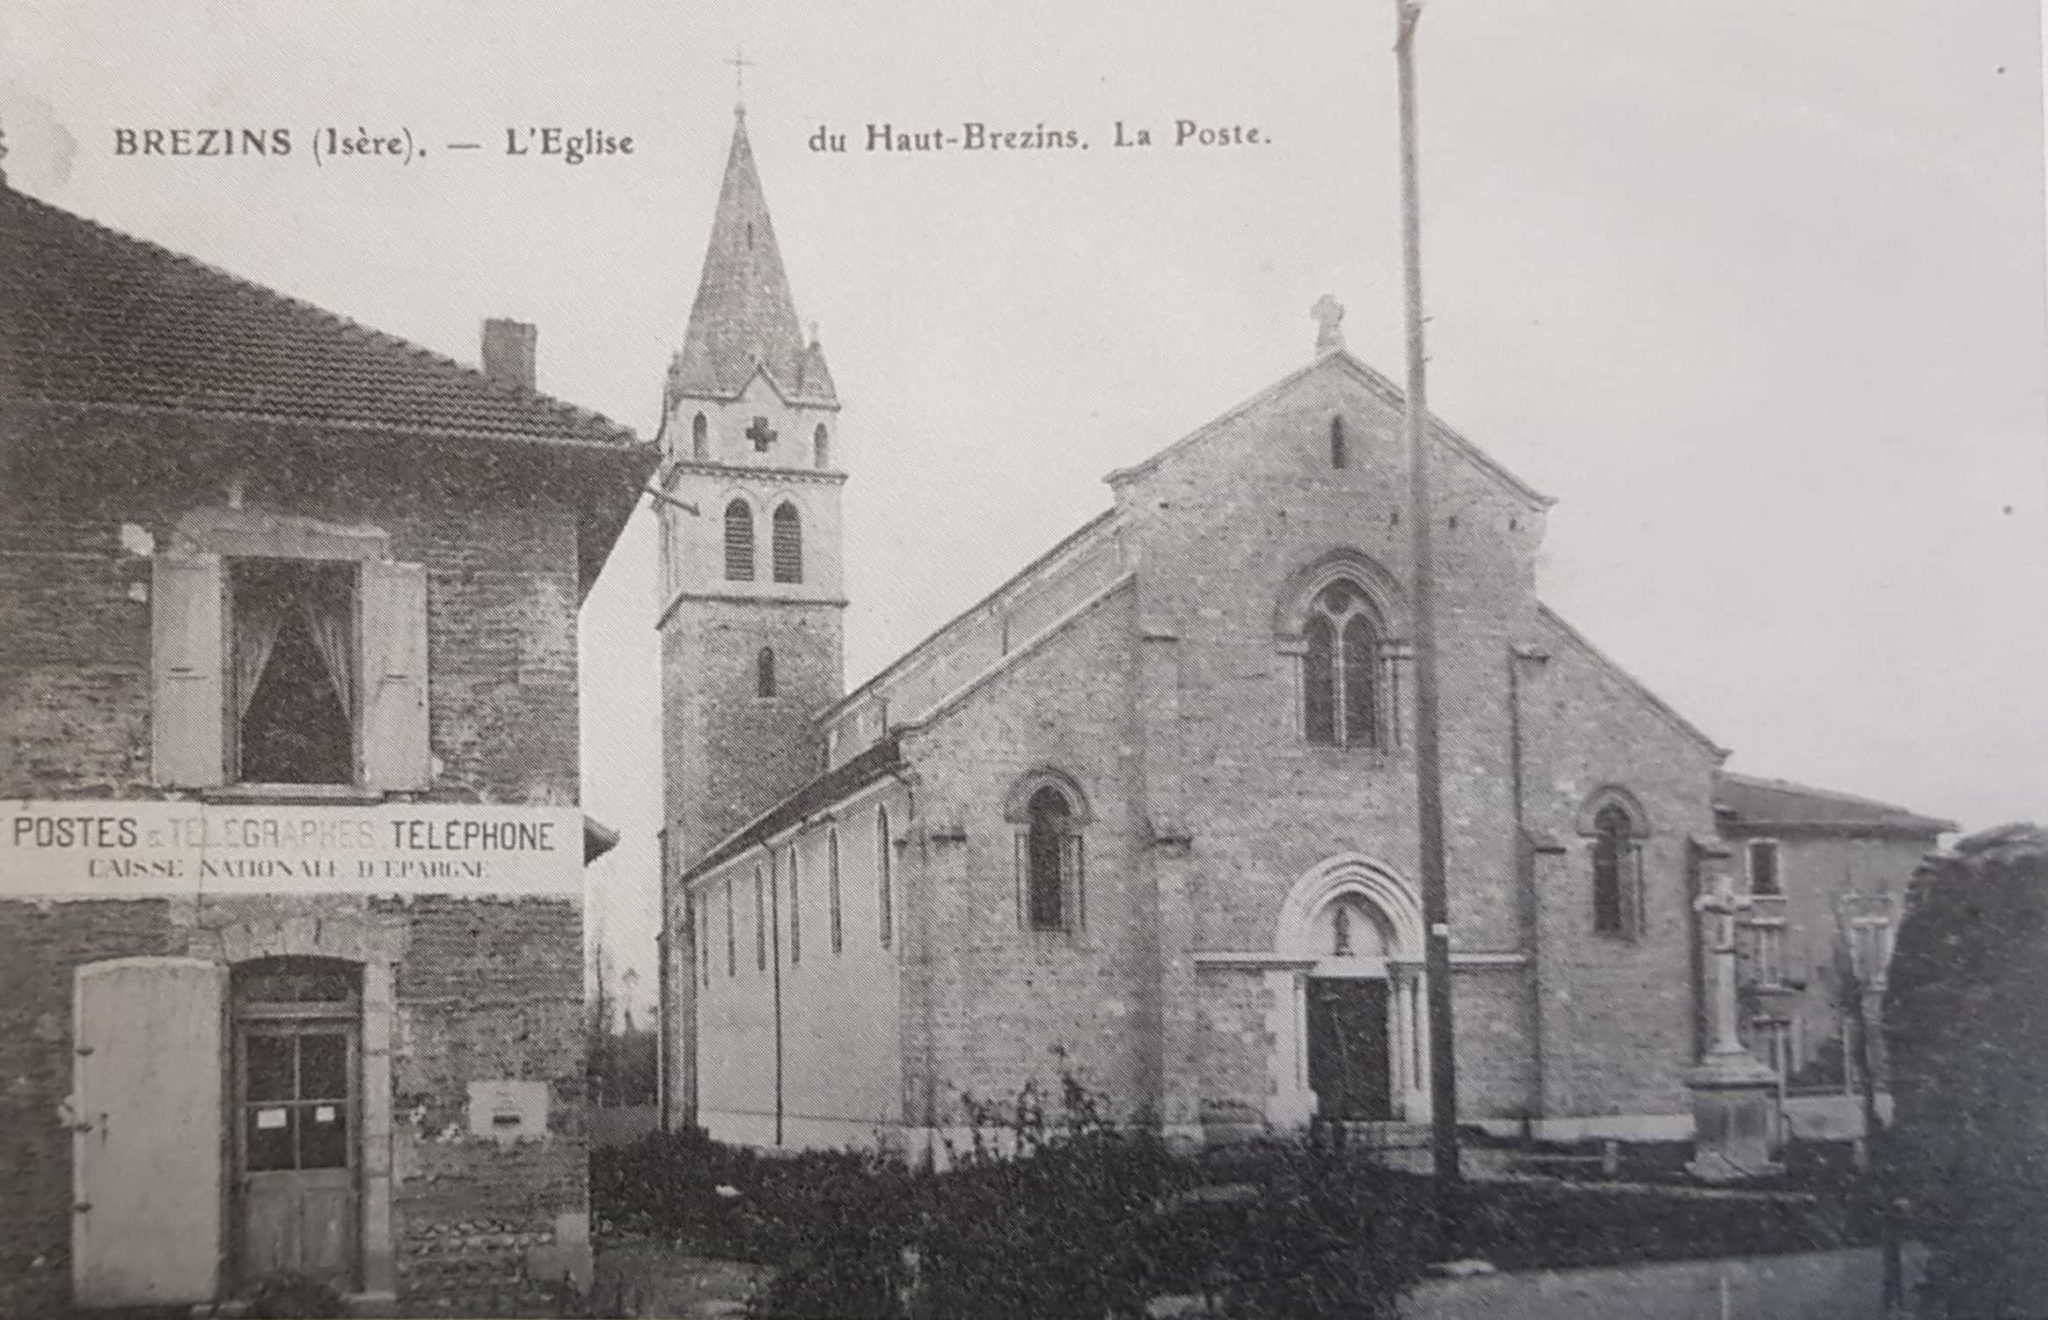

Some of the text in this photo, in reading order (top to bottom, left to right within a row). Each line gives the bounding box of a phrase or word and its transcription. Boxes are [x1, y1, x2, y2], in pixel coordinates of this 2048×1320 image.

[14, 816, 138, 848] POSTES
[88, 858, 184, 879] CAISSE
[200, 859, 343, 879] NATIONALE
